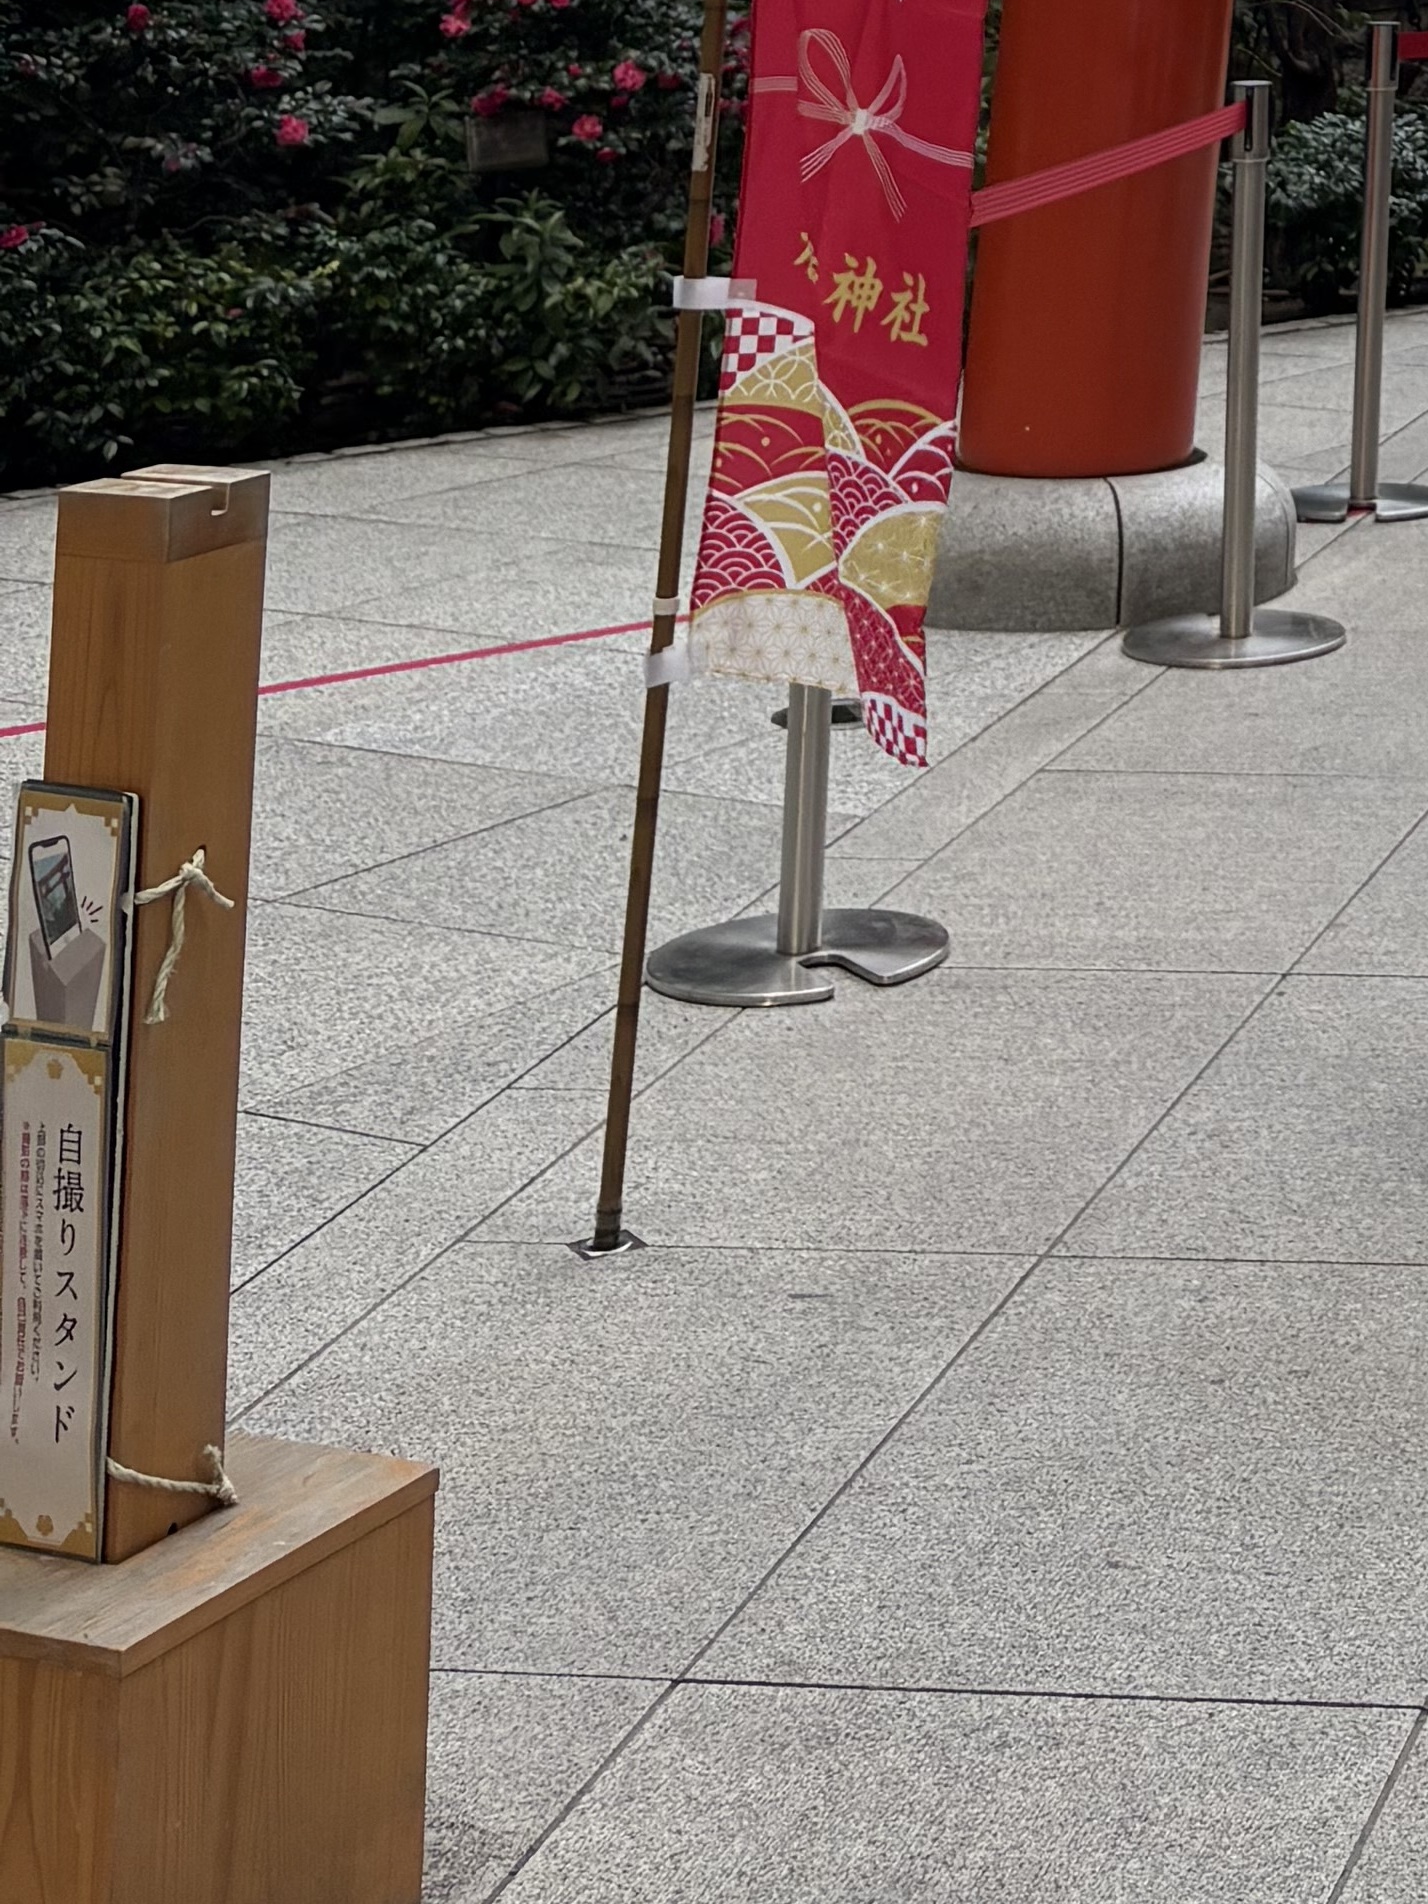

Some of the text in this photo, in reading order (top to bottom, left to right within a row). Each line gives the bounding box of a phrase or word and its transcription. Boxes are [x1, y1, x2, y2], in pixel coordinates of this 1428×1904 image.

[52, 1123, 85, 1445] 自撮りスタンド
